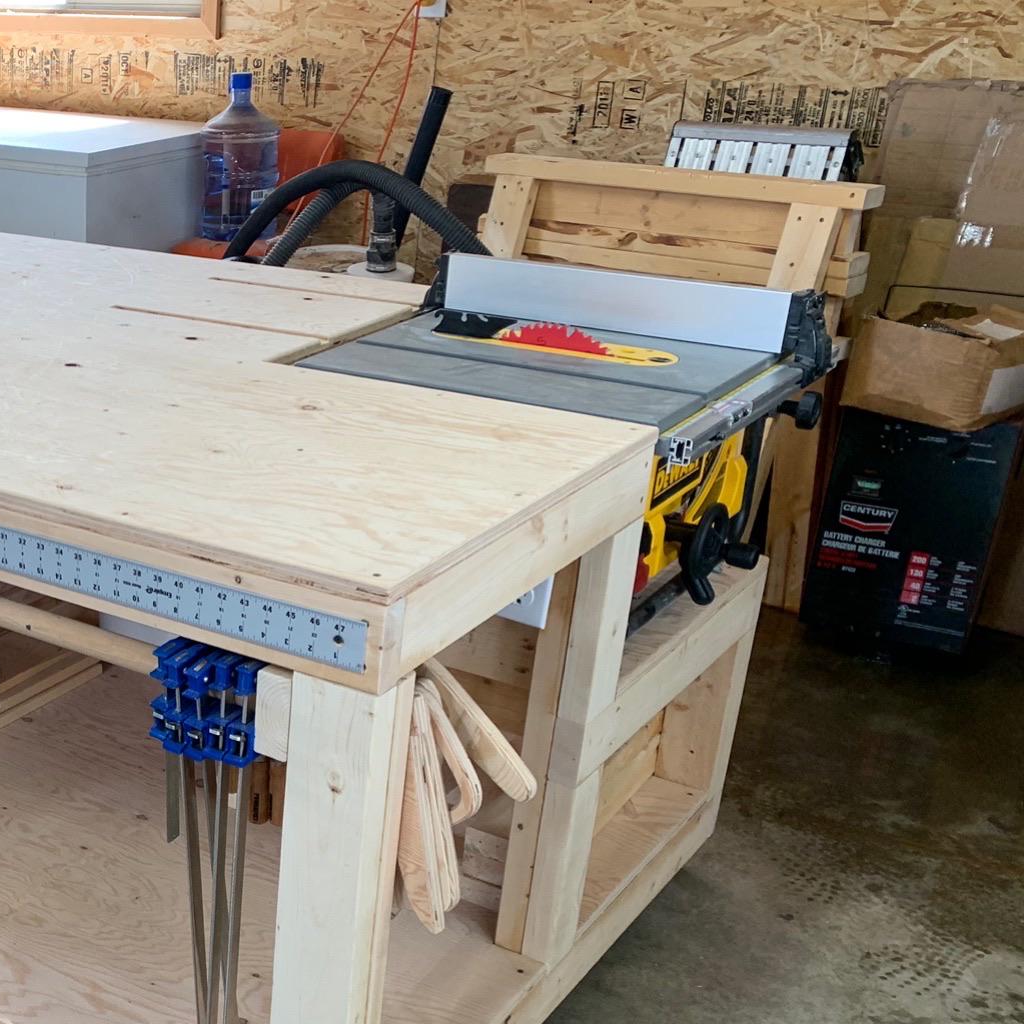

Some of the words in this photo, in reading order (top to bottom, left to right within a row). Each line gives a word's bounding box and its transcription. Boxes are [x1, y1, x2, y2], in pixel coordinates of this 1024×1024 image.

[843, 503, 895, 519] CENTURY
[823, 530, 853, 543] BATTERY
[854, 535, 886, 548] CHARGER
[93, 558, 102, 566] 36
[112, 563, 122, 572] 37
[132, 569, 142, 577] 38
[153, 574, 162, 583] 39
[174, 580, 184, 589] 40
[195, 586, 204, 595] 41
[217, 592, 227, 601] 42
[239, 598, 250, 607] 43
[262, 604, 272, 614] 44
[286, 611, 296, 620] 45
[310, 617, 320, 626] 46
[334, 624, 346, 633] 47
